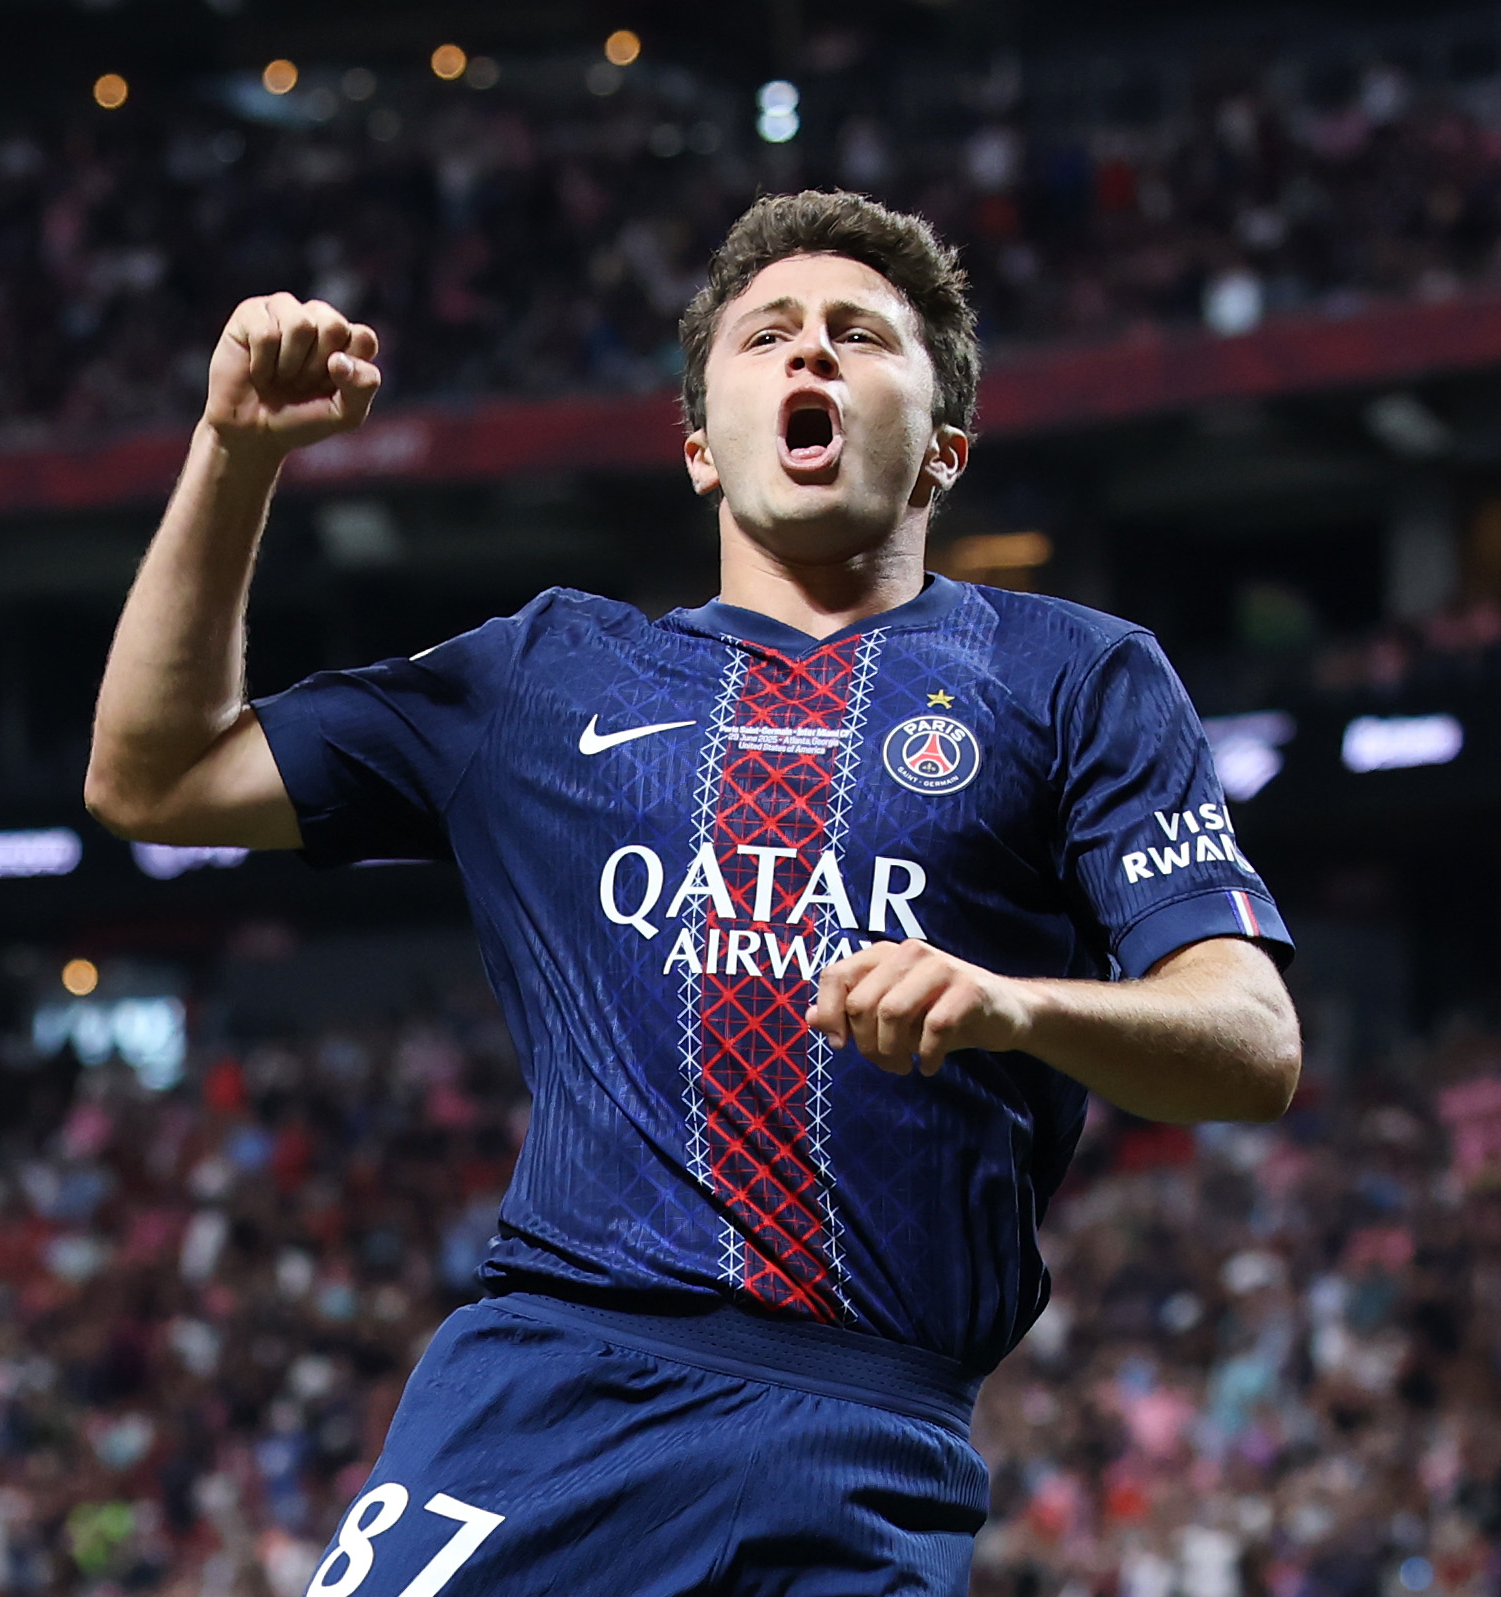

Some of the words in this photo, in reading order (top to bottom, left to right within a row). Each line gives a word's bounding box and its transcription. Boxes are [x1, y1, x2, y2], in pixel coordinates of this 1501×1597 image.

[739, 733, 757, 742] June
[758, 735, 778, 743] 2025
[903, 719, 966, 743] PARIS
[738, 741, 762, 750] United
[762, 743, 786, 753] States
[795, 745, 826, 755] America
[923, 774, 960, 788] GERMAIN
[600, 842, 927, 940] QATAR
[663, 927, 872, 980] AIRWA
